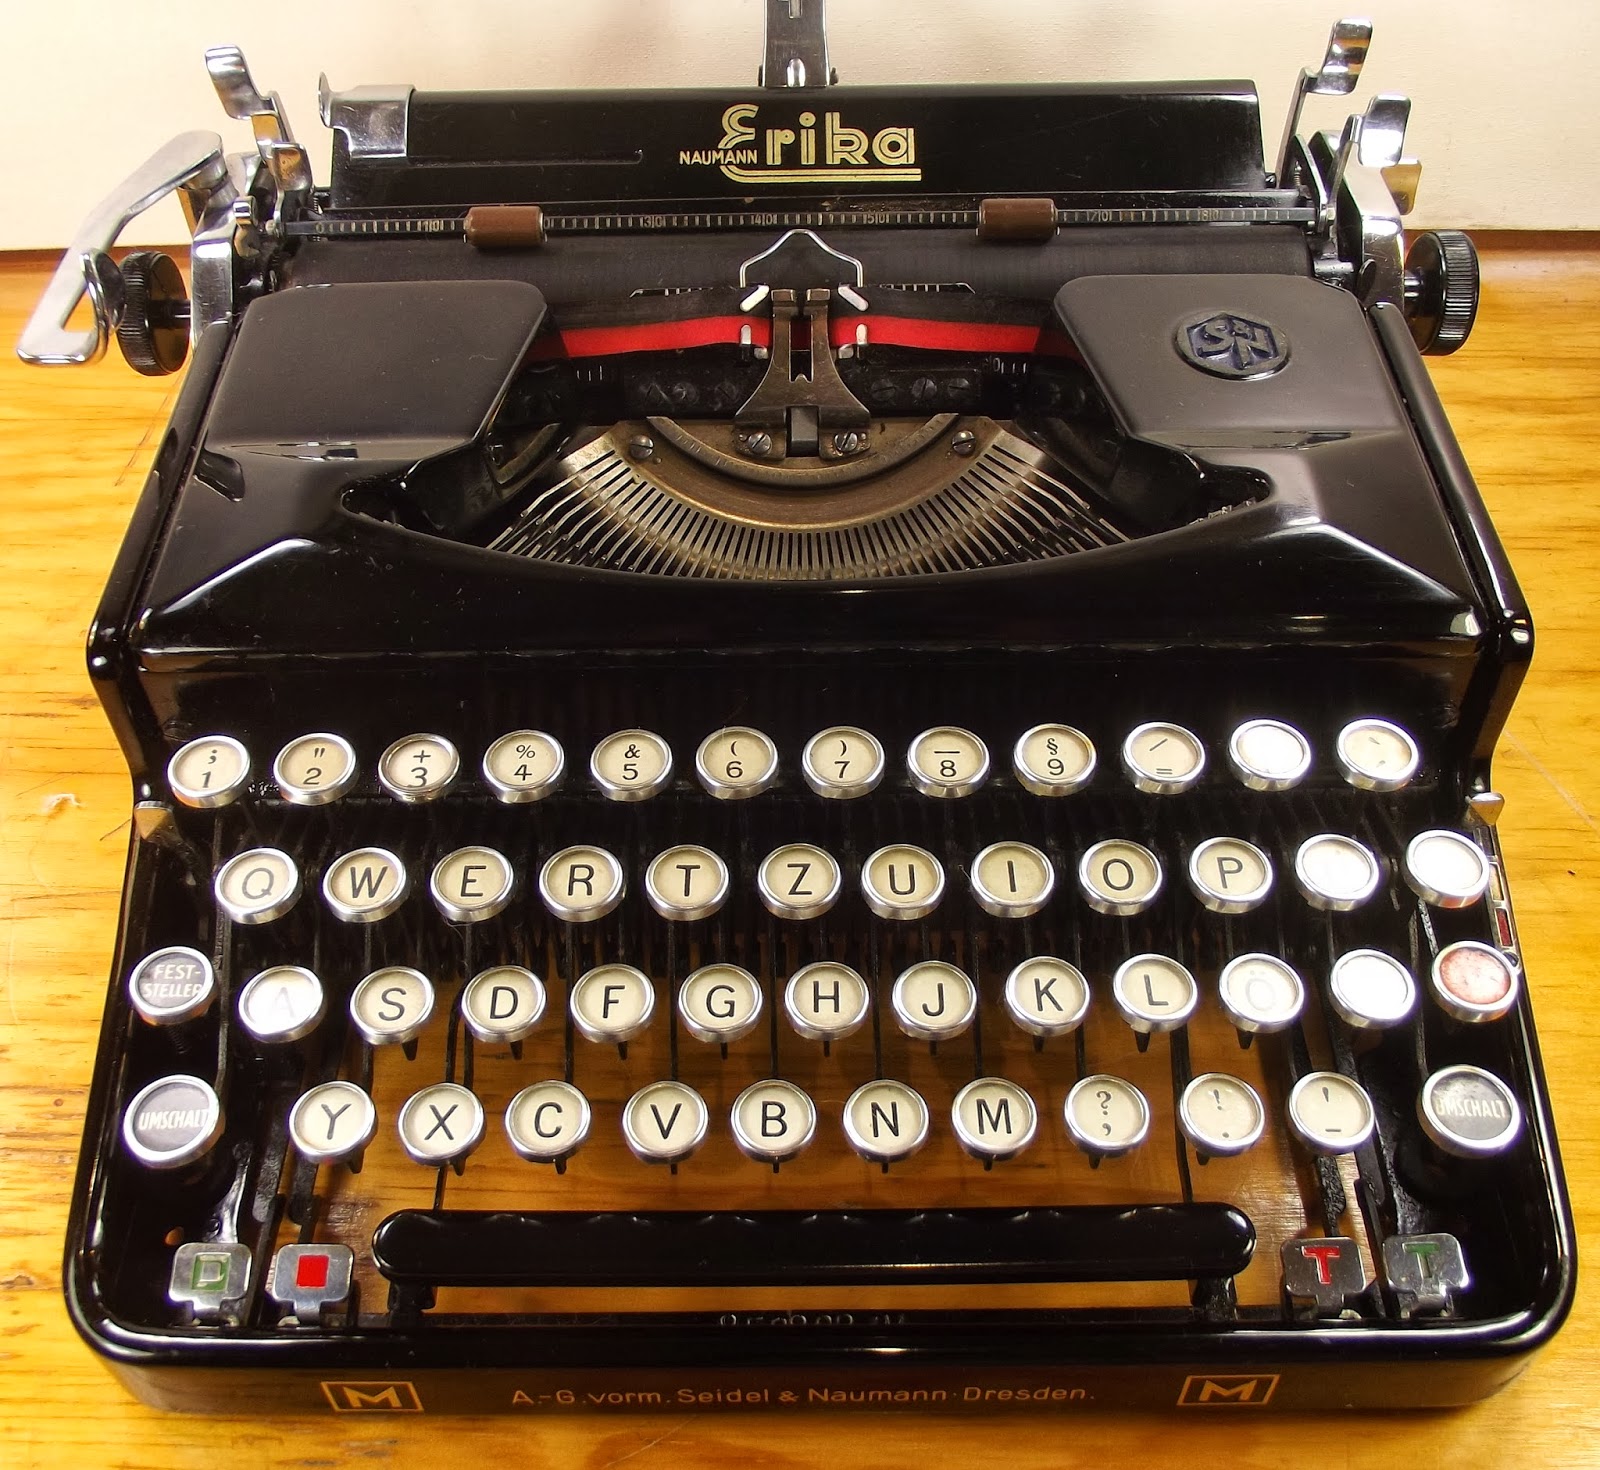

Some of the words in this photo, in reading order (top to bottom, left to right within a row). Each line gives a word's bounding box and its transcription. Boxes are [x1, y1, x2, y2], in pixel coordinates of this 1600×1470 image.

[717, 103, 917, 170] Erika
[679, 149, 758, 165] NAUMANN
[203, 772, 211, 788] 1
[303, 768, 321, 784] 2
[410, 767, 428, 787] 3
[514, 765, 532, 780] 4
[623, 764, 638, 780] 5
[726, 761, 743, 778] 6
[835, 761, 850, 778] 7
[940, 760, 956, 777] 8
[1048, 759, 1064, 775] 9
[241, 868, 273, 899] Q
[350, 866, 388, 898] W
[461, 866, 486, 896] E
[567, 865, 594, 896] R
[676, 865, 700, 896] T
[788, 864, 812, 895] Z
[889, 865, 915, 895] U
[1007, 861, 1016, 892] I
[1103, 859, 1133, 890] O
[1217, 857, 1243, 888] P
[153, 964, 201, 980] FEST-
[271, 986, 296, 1019] A
[379, 988, 406, 1021] S
[490, 987, 518, 1019] D
[603, 986, 625, 1018] F
[706, 985, 734, 1018] G
[813, 981, 839, 1012] H
[923, 983, 944, 1016] J
[1035, 978, 1063, 1011] K
[1144, 975, 1168, 1006] L
[138, 1109, 208, 1131] UMSCHALT
[322, 1104, 351, 1139] Y
[425, 1105, 458, 1140] X
[535, 1102, 562, 1138] C
[651, 1104, 681, 1139] V
[762, 1101, 787, 1137] B
[871, 1102, 899, 1137] N
[977, 1099, 1011, 1134] M
[1435, 1098, 1506, 1118] UMSCHALT
[1301, 1246, 1340, 1285] T
[1402, 1243, 1440, 1280] T
[343, 1386, 403, 1408] M
[677, 1389, 769, 1403] Seidel
[778, 1390, 798, 1403] &
[963, 1386, 1095, 1401] Dresden.
[1200, 1380, 1258, 1401] M
